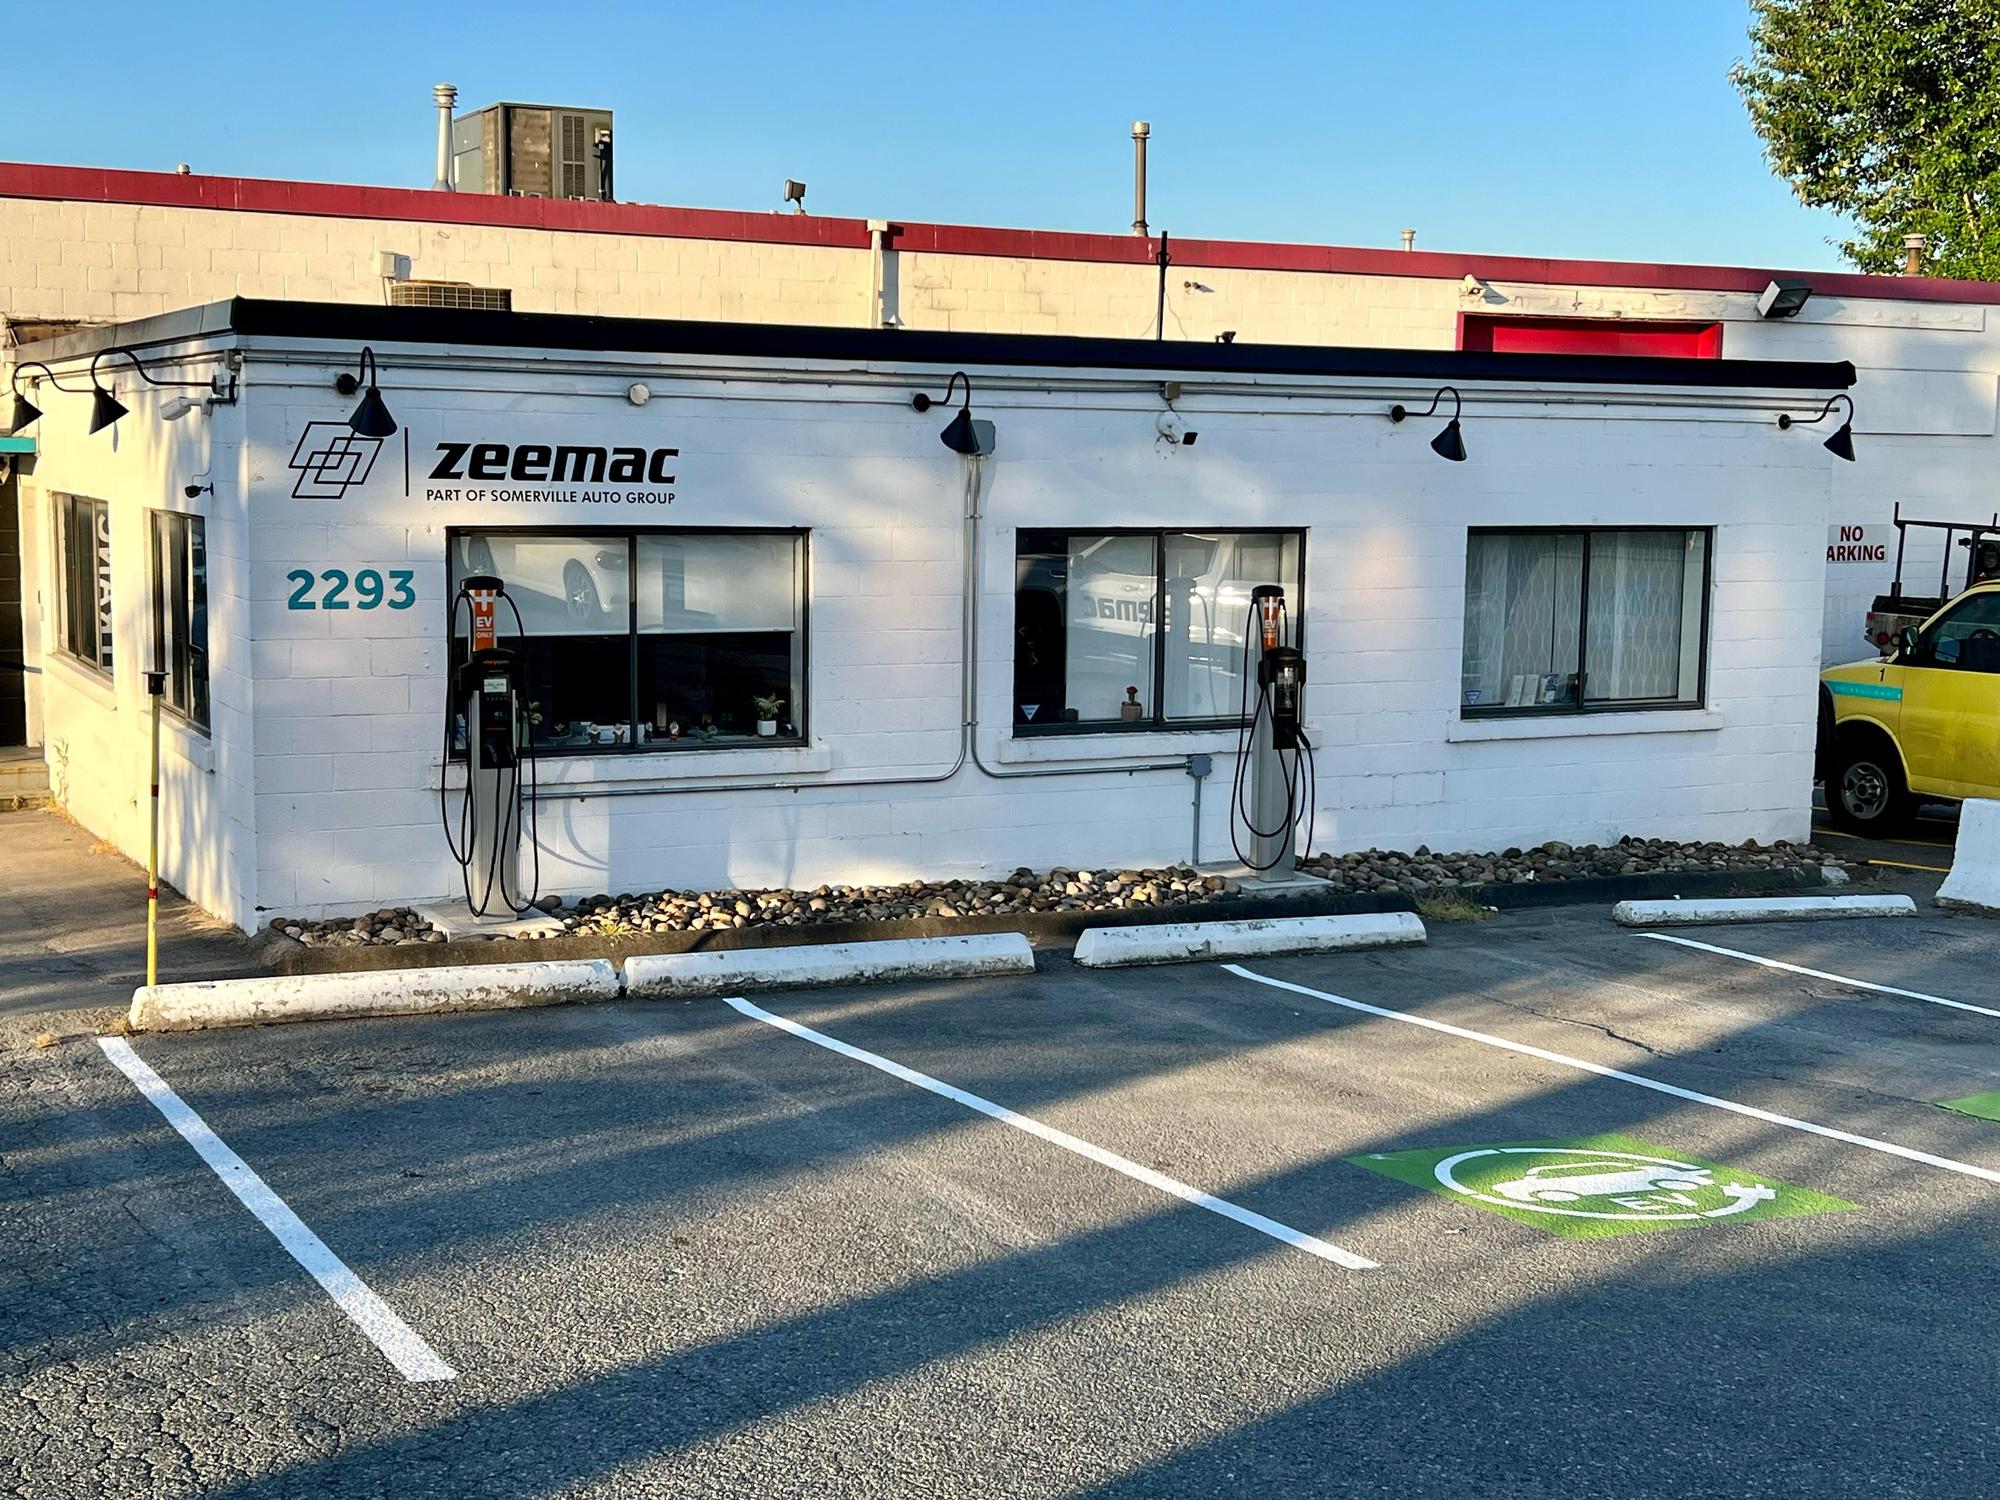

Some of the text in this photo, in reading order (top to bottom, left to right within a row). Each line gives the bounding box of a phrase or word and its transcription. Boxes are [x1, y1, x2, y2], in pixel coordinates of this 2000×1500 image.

[428, 443, 680, 484] zeemac
[426, 489, 676, 505] PART OF SOMERVILLE AUTO GROUP
[1840, 526, 1864, 542] NO
[1826, 545, 1885, 561] ARKING
[286, 569, 416, 610] 2293
[476, 616, 493, 627] EV
[1879, 667, 1886, 682] 1
[1609, 1192, 1698, 1210] EV
